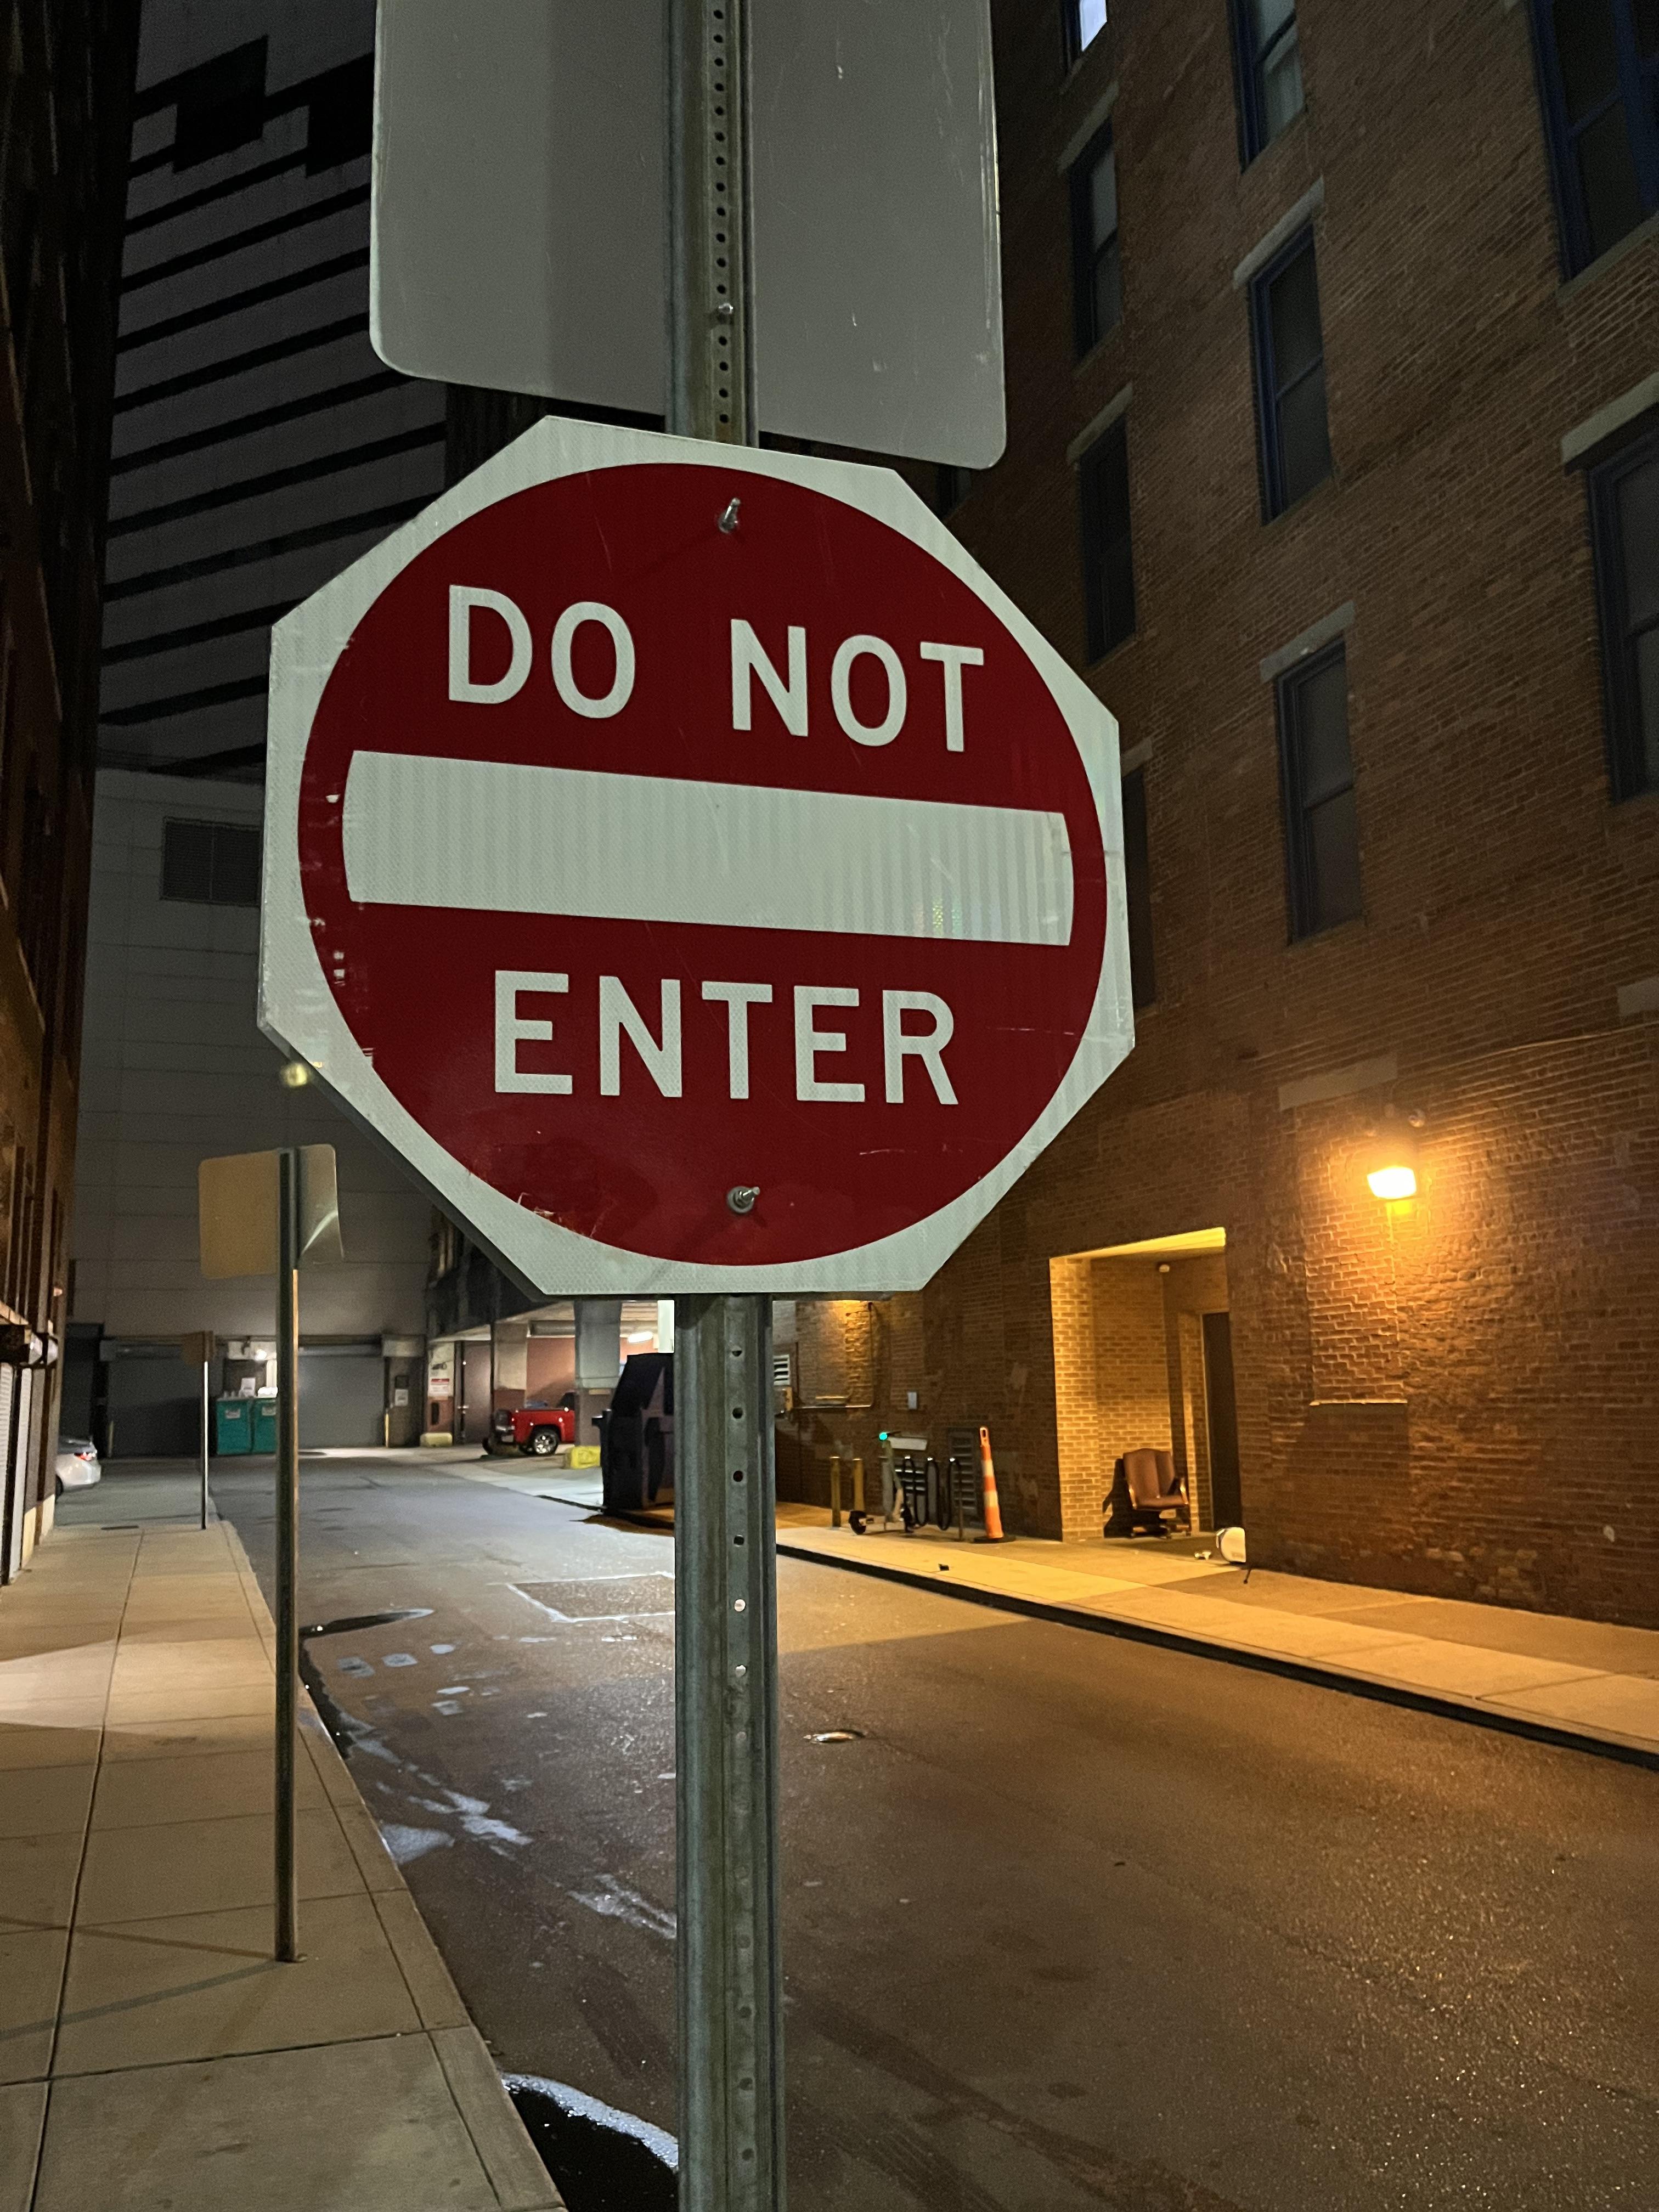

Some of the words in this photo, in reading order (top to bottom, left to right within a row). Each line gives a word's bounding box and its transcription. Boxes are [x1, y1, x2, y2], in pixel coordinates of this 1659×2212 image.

[448, 584, 636, 719] DO
[730, 618, 985, 753] NOT
[494, 970, 959, 1105] ENTER
